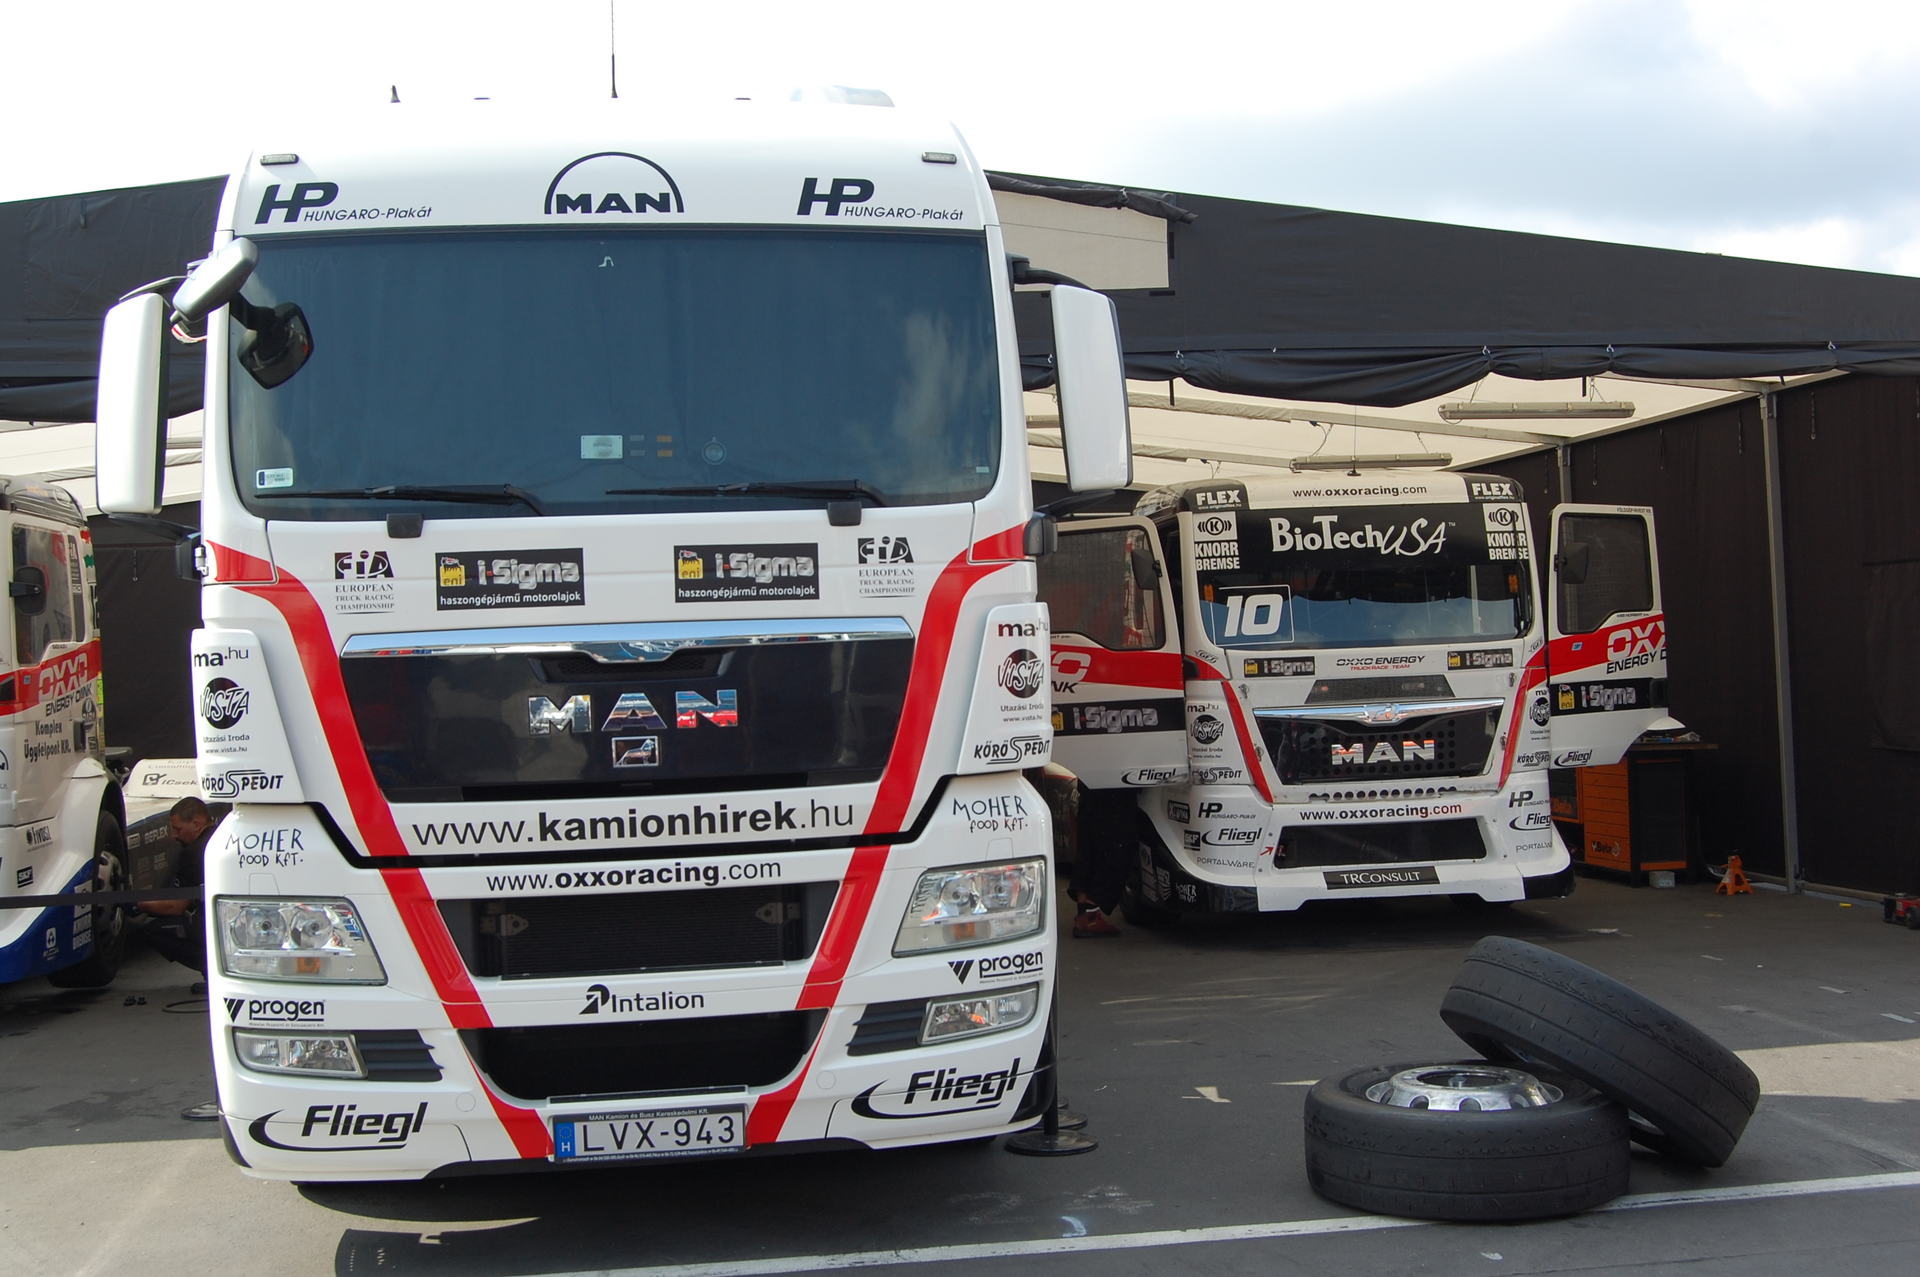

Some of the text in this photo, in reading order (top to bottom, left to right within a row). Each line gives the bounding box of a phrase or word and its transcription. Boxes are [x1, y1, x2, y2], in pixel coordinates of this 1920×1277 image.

[254, 181, 339, 224] HP
[556, 192, 671, 214] MAN
[797, 177, 875, 216] HP
[303, 206, 432, 222] HUNGARO-Plakát
[844, 206, 964, 221] HUNGARO-Plakát
[1196, 490, 1241, 506] FLEX
[1293, 485, 1427, 497] www.oxxoracing.com
[1471, 483, 1513, 496] FLEX
[1195, 541, 1239, 557] KNORR
[715, 552, 814, 583] i-Sigma
[859, 568, 914, 577] EUROPEAN
[1196, 557, 1240, 571] BREMSE
[443, 574, 462, 586] eni
[477, 559, 580, 590] i-Sigma
[681, 568, 700, 579] eni
[335, 583, 394, 593] EUROPEAN
[678, 585, 816, 599] haszongépjármű motorolajok
[335, 603, 395, 611] CHAMPIONSHIP
[440, 591, 581, 606] haszongépjármű motorolajok
[1224, 594, 1284, 637] 10
[1375, 655, 1425, 665] ENERGY
[1606, 651, 1657, 674] ENERGY
[998, 657, 1044, 691] VISTA
[200, 686, 250, 721] VISTA
[528, 689, 738, 734] MAN
[1073, 706, 1159, 733] i-Sigma
[228, 733, 250, 742] Iroda
[1331, 740, 1435, 765] MAN
[952, 795, 1028, 820] MOHER
[1198, 802, 1223, 819] HP
[1299, 802, 1462, 822] www.oxxoracing.com
[412, 799, 854, 846] www.kamionhirek.hu
[1526, 813, 1551, 826] Flieg
[225, 828, 304, 855] MOHER
[1217, 827, 1263, 843] Fliegl
[1515, 841, 1552, 853] PORTALW
[1197, 857, 1255, 869] PORTALWARE
[18, 869, 33, 882] SKF
[486, 860, 782, 892] www.oxxoracing.com
[979, 951, 1043, 979] progen
[250, 1000, 325, 1021] progen
[612, 991, 704, 1013] Intalion
[904, 1057, 1021, 1105] Fliegl
[301, 1102, 428, 1143] Fliegl
[605, 1113, 629, 1121] Kamion
[639, 1111, 655, 1119] Busz
[656, 1109, 697, 1118] Kereskedelmi
[583, 1115, 735, 1152] LVX-943
[561, 1141, 571, 1152] H
